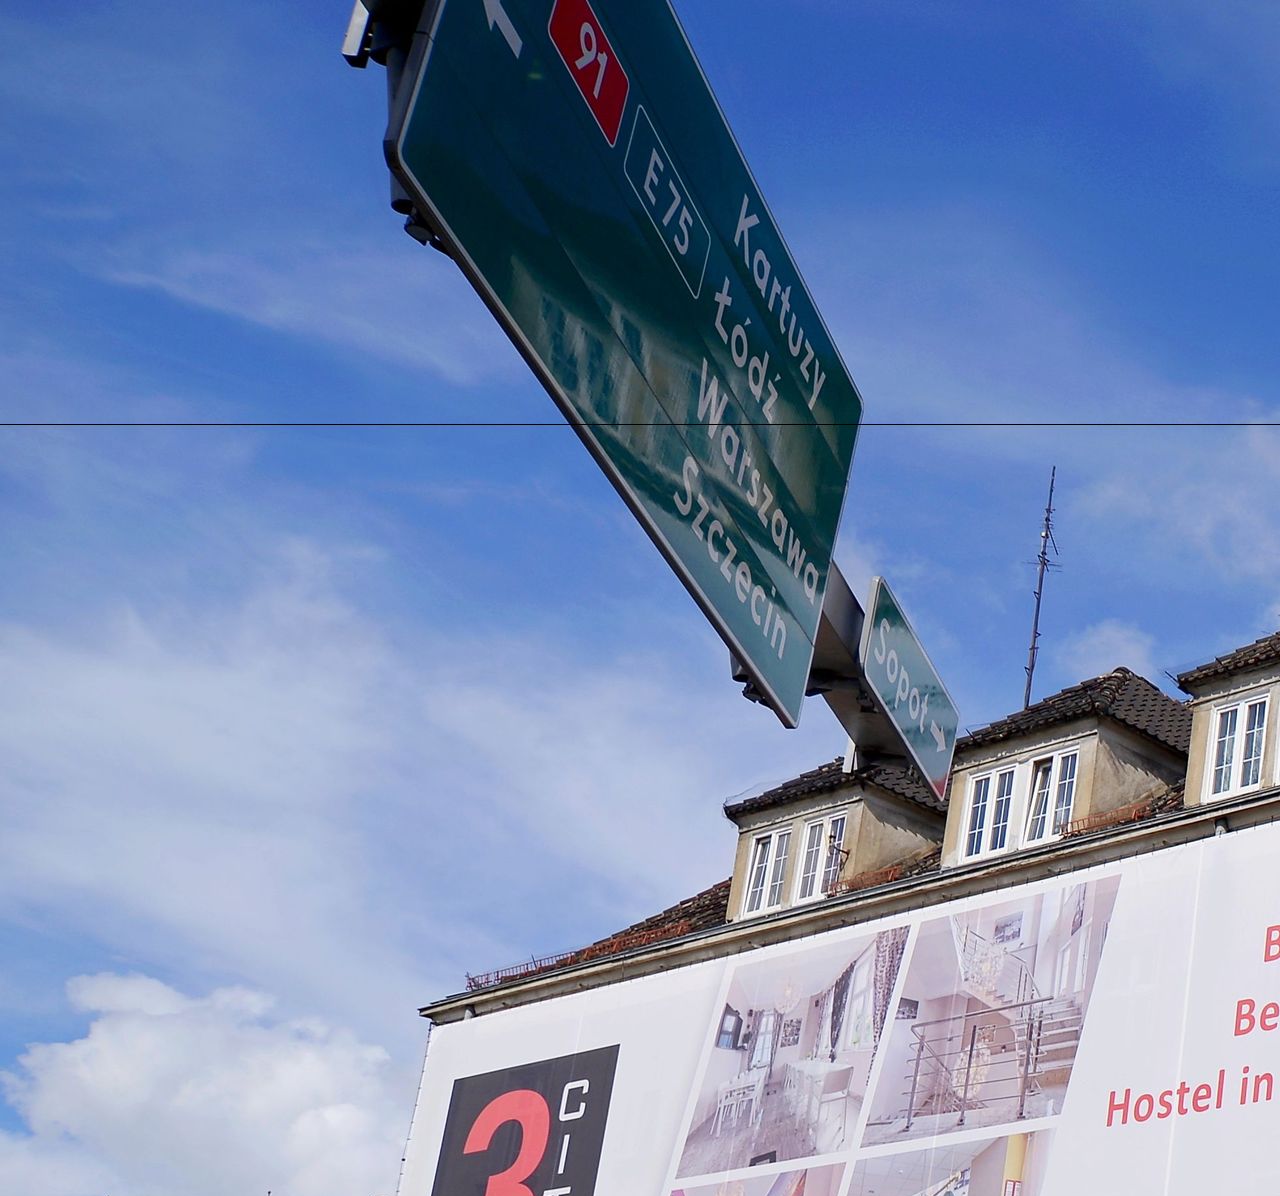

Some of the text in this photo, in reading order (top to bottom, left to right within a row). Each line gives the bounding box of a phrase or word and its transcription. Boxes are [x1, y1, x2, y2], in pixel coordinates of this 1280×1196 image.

[575, 21, 609, 99] 91
[644, 148, 693, 255] E75
[715, 277, 783, 424] Łódź
[734, 194, 826, 410] Kartuzy
[700, 358, 819, 605] Warszawa
[673, 455, 787, 660] Szczecin
[874, 618, 930, 733] Sopot
[1106, 1069, 1225, 1127] Hostel
[1239, 1066, 1274, 1105] in
